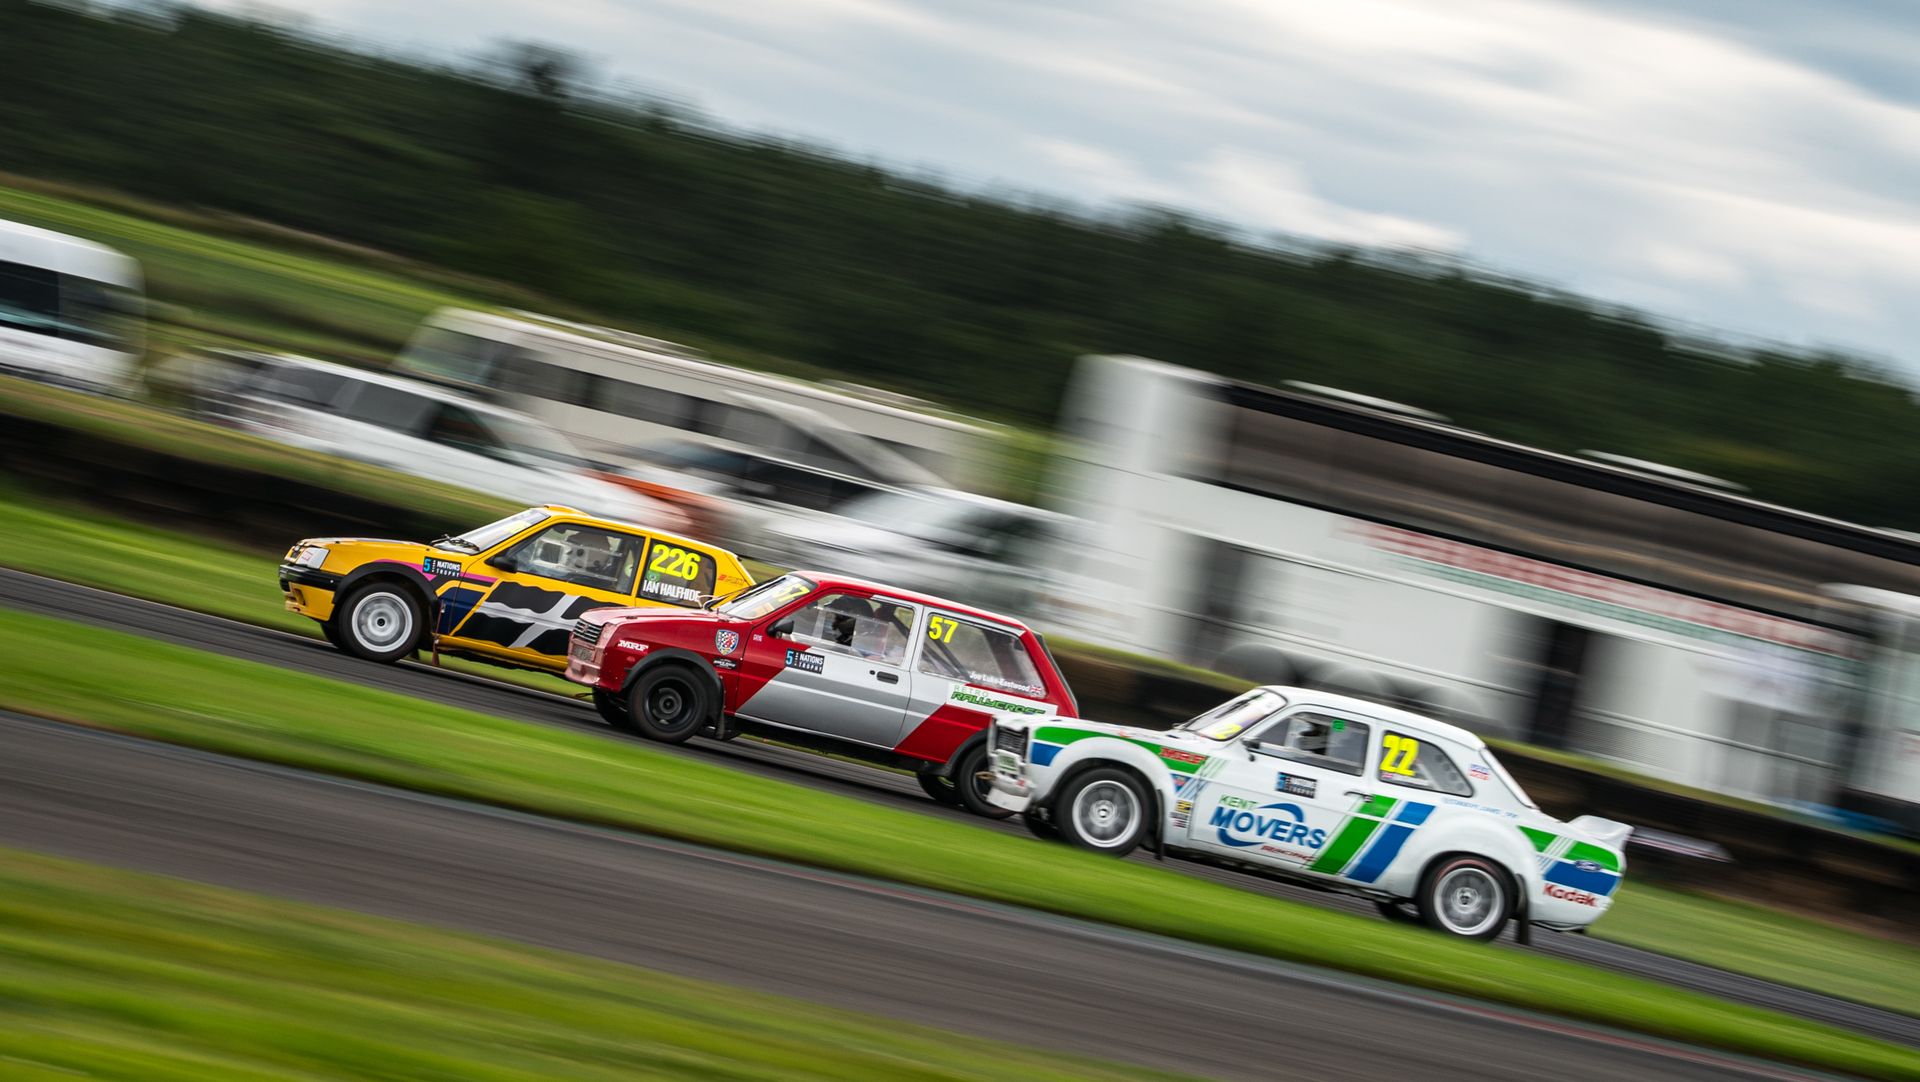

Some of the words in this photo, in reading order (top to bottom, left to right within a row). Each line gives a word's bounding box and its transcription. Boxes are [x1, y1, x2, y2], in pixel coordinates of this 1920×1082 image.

[423, 558, 432, 572] 5
[437, 560, 460, 571] NATIONS
[649, 544, 702, 580] 226
[643, 580, 660, 594] IAN
[660, 583, 702, 602] HALFHIDE
[928, 615, 958, 643] 57
[617, 639, 649, 652] MRF
[785, 650, 794, 665] 5
[800, 653, 824, 665] NATIONS
[953, 683, 989, 697] RETRO
[1379, 734, 1419, 776] 22
[1219, 794, 1258, 810] KENT
[1208, 806, 1327, 849] MOVERS
[1543, 882, 1597, 907] Kodak
